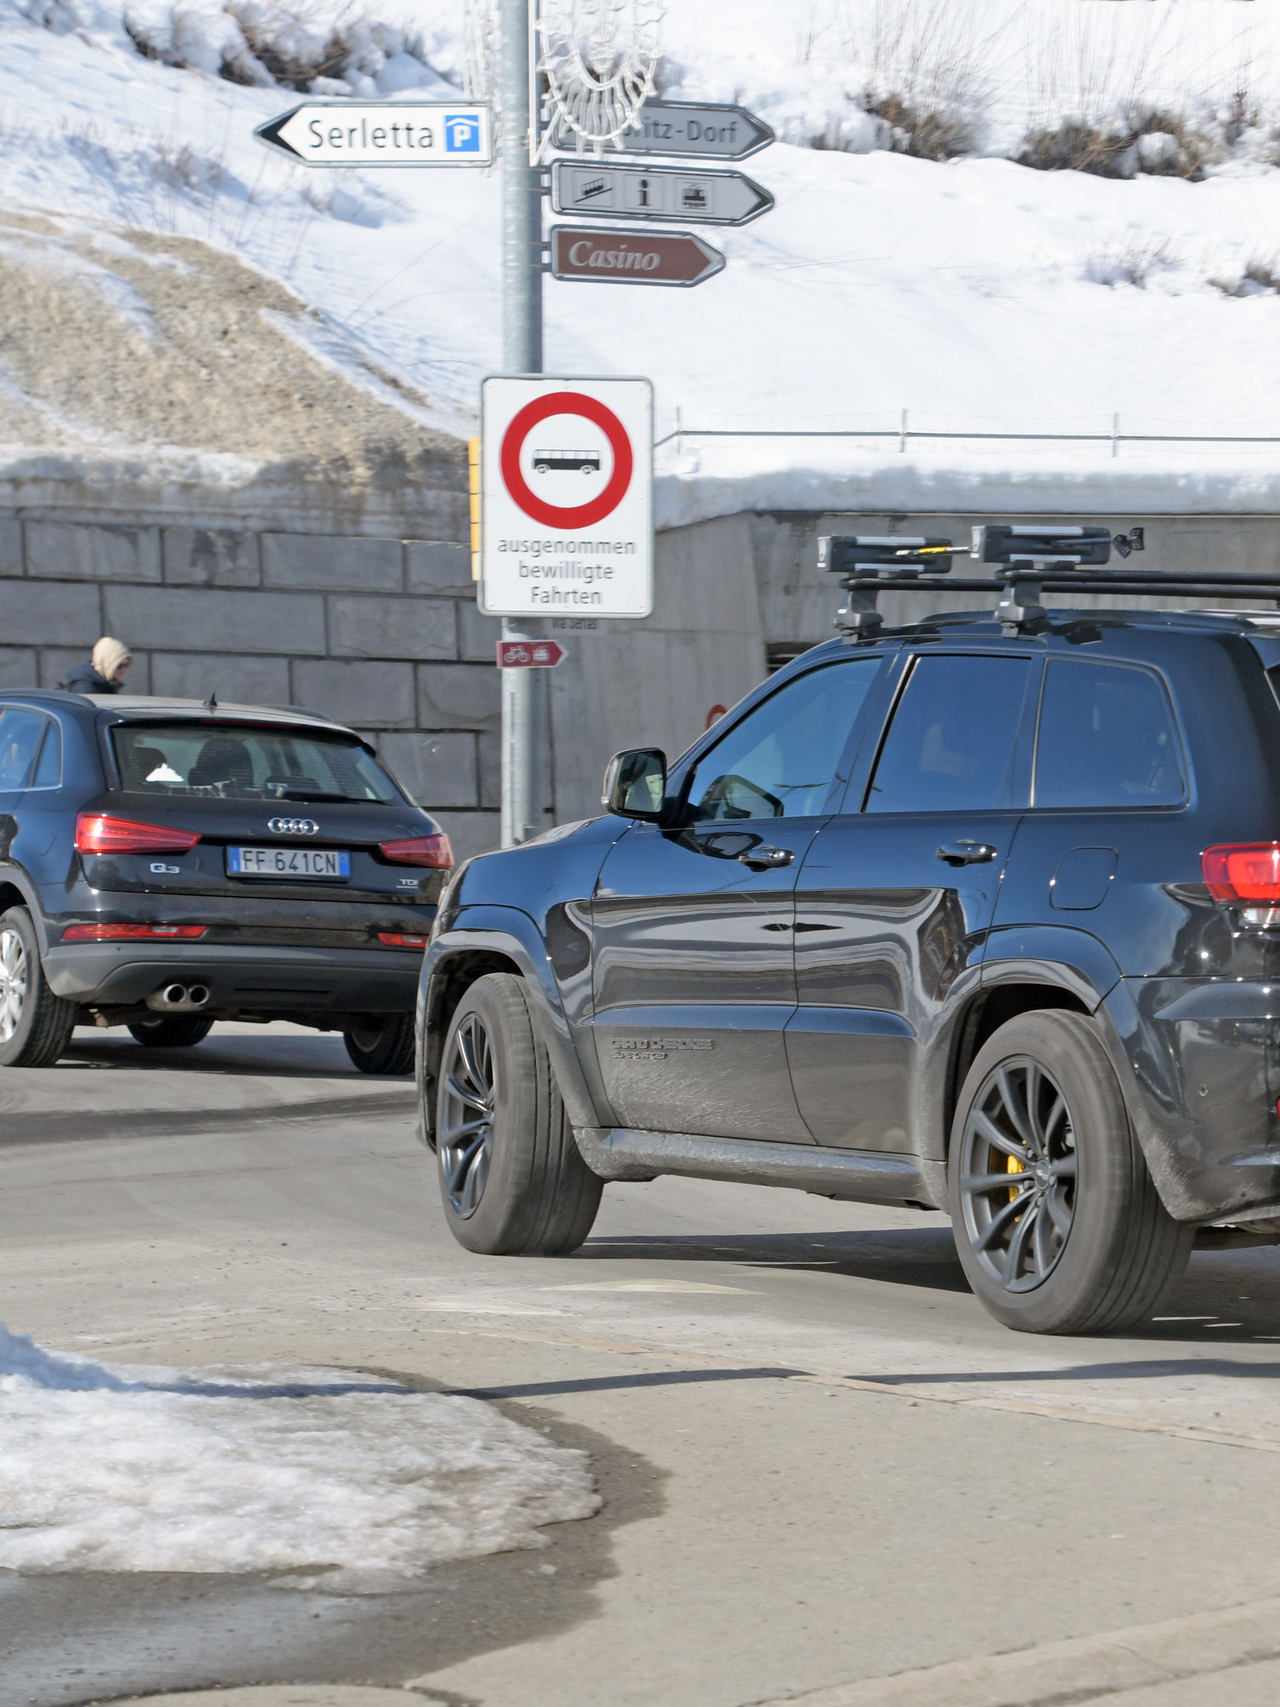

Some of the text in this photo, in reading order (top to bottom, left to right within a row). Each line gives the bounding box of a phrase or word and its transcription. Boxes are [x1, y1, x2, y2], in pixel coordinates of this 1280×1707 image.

[309, 118, 433, 149] Serletta
[568, 240, 661, 271] Casino
[498, 539, 637, 557] ausgenommen
[518, 559, 615, 584] bewilligte
[530, 585, 603, 605] Fahrten
[150, 862, 181, 875] Q3
[243, 850, 266, 871] FF
[274, 850, 337, 874] 641CN
[399, 878, 419, 886] TDI
